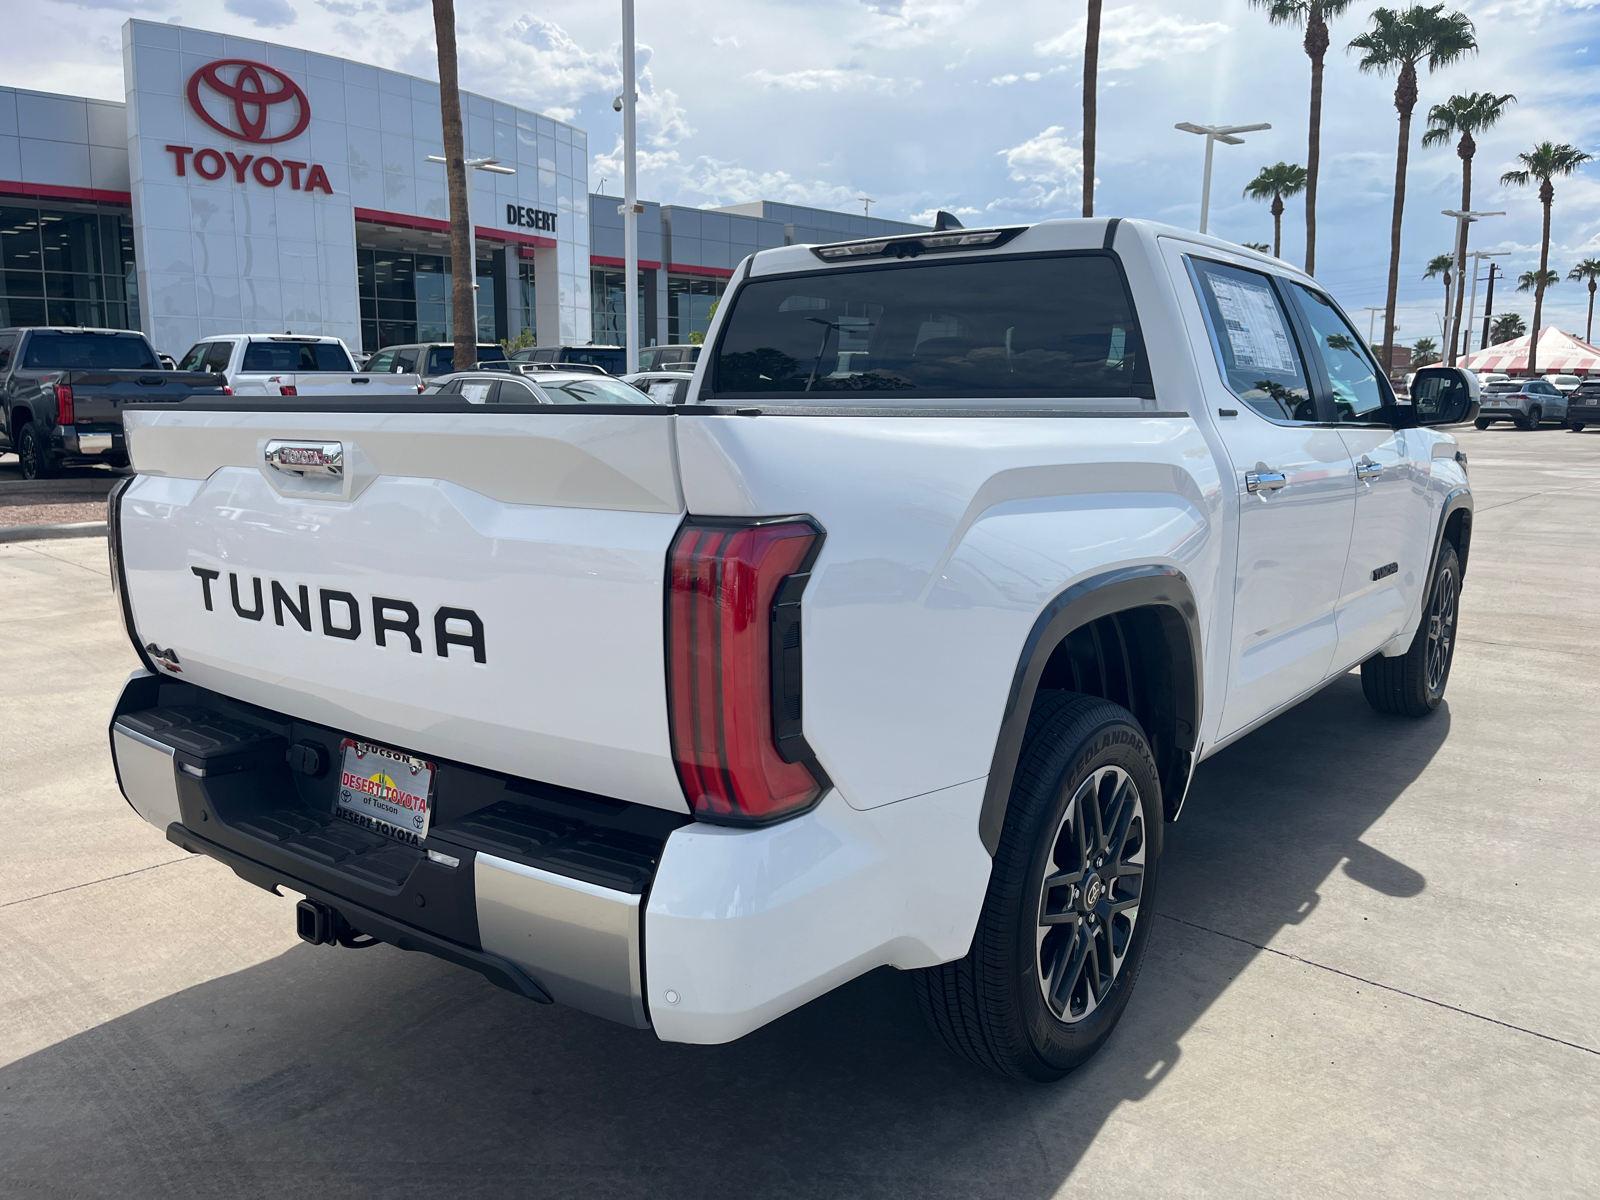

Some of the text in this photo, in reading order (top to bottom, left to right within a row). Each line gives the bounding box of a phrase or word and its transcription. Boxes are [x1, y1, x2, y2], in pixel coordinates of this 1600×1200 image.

[166, 144, 334, 195] TOYOTA
[506, 204, 557, 232] DESERT
[284, 449, 320, 464] TOYOTA
[191, 566, 487, 664] TUNDRA
[365, 743, 411, 763] TUCSON
[1067, 730, 1145, 791] GEOLANDAR
[342, 772, 427, 813] DESERT TOYOTA
[363, 796, 398, 815] of Tucson
[335, 807, 419, 846] DESERT TOYOTA
